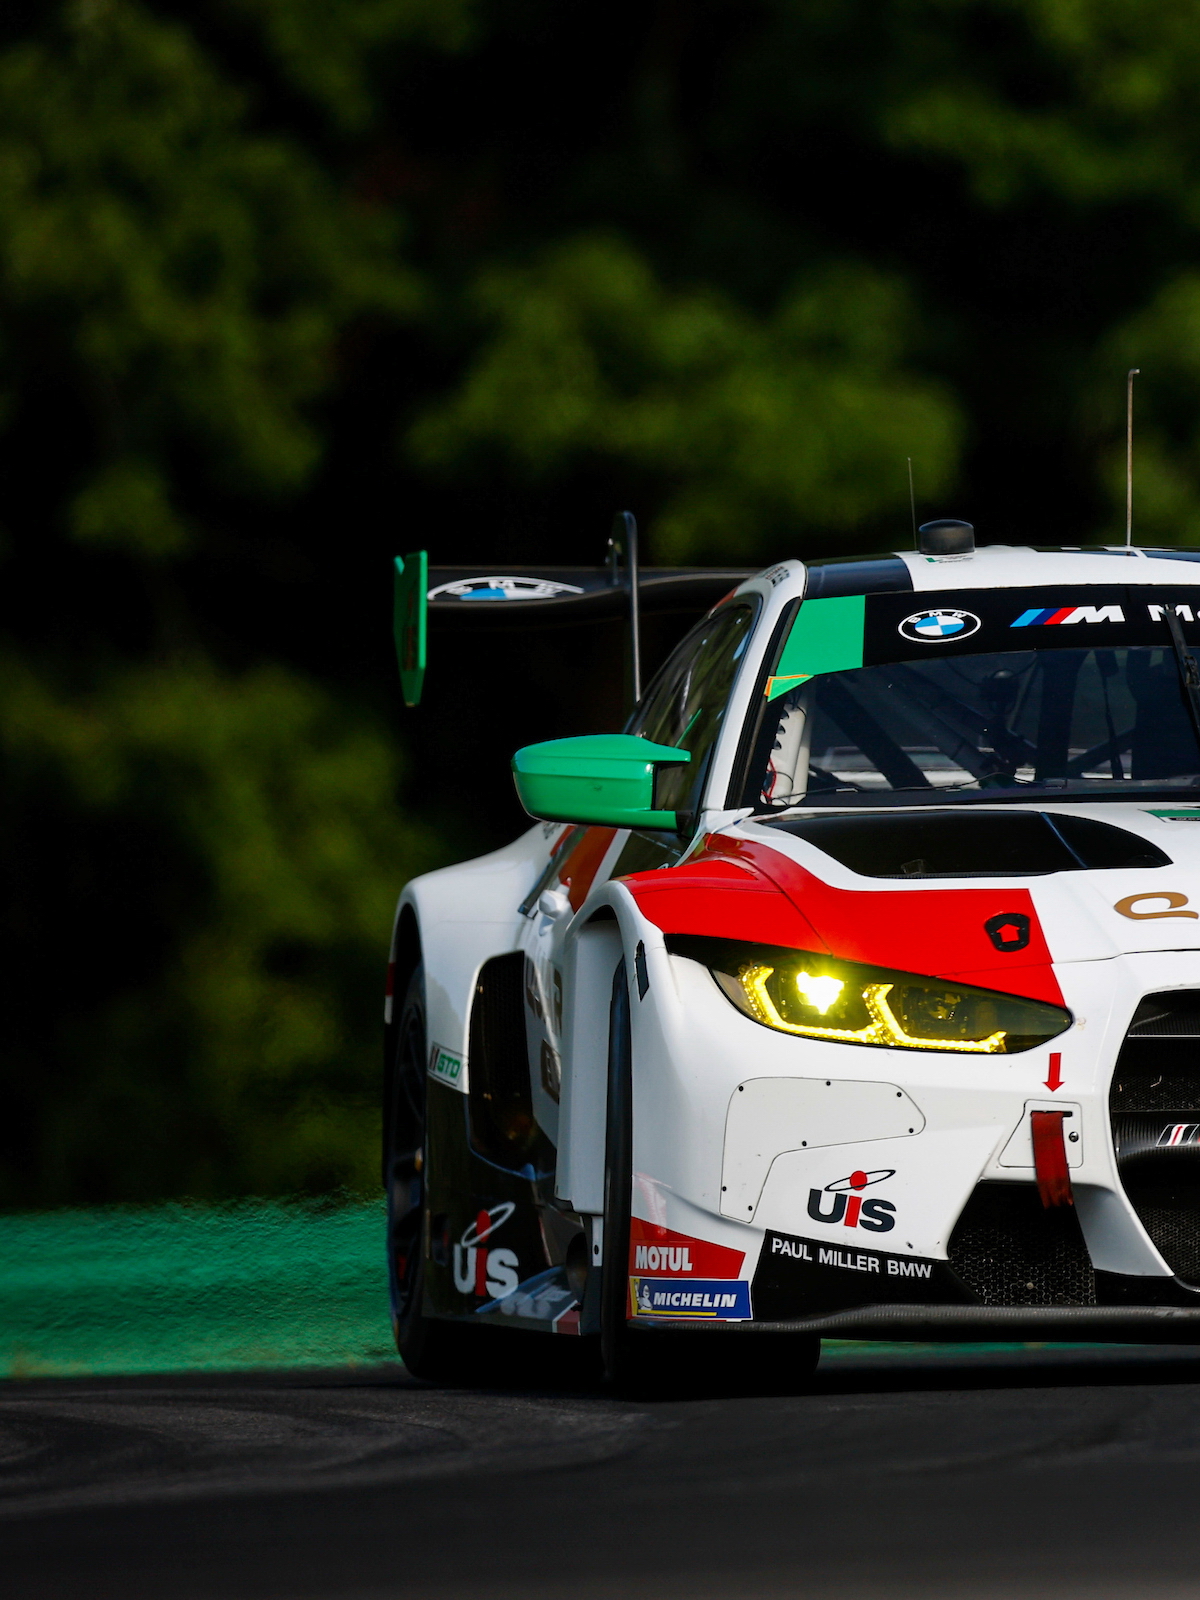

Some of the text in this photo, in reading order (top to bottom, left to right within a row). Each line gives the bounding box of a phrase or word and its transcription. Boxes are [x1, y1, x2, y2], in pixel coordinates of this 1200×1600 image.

[1060, 604, 1126, 625] M
[437, 1053, 461, 1078] GTD
[635, 1245, 693, 1272] MOTUL
[771, 1237, 933, 1279] PAUL MILLER BMW
[653, 1292, 737, 1308] MICHELIN
